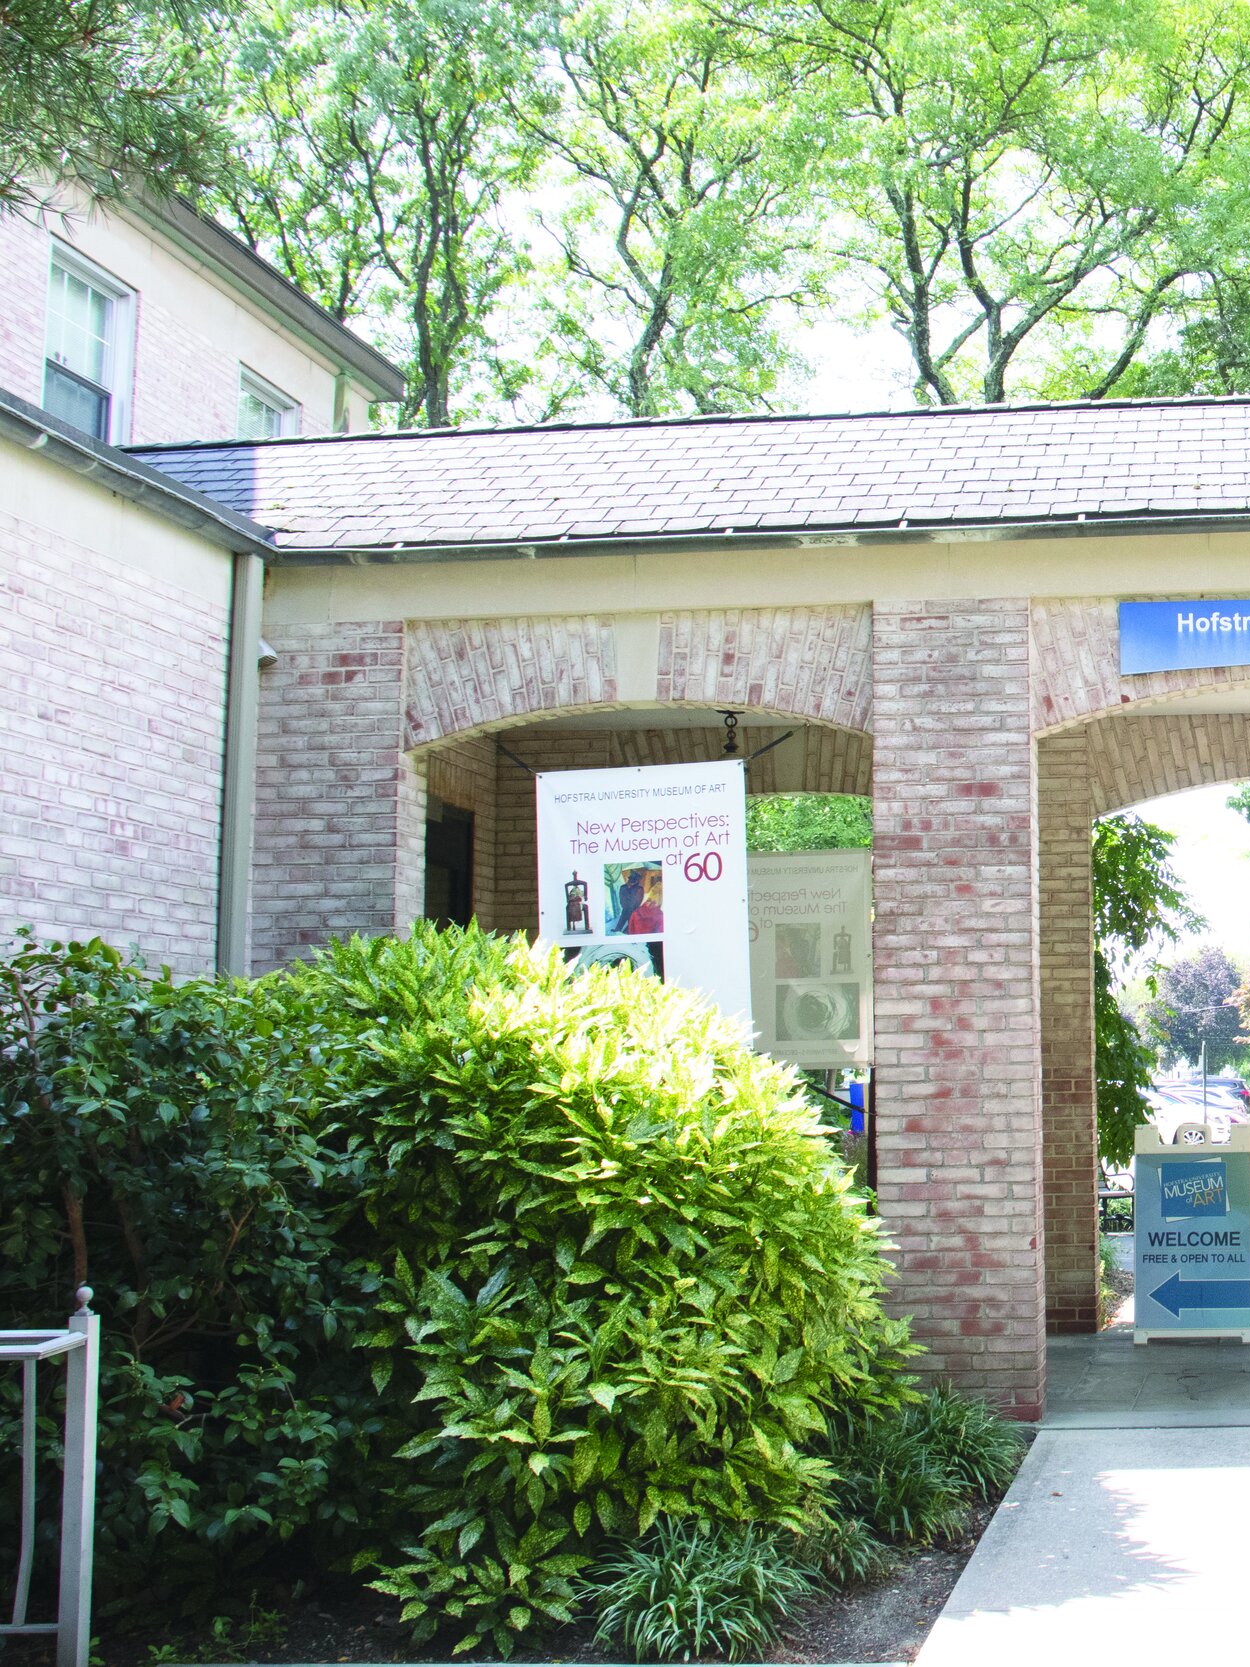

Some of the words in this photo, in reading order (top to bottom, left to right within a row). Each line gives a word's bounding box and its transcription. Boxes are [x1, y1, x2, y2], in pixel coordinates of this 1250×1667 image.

[554, 792, 596, 804] HOFSTRA
[598, 788, 651, 801] UNIVERSITY
[652, 785, 692, 797] MUSEUM
[694, 784, 706, 794] OF
[708, 783, 726, 793] ART
[577, 820, 616, 835] New
[621, 813, 730, 834] Perspectives:
[570, 839, 599, 854] The
[604, 837, 677, 852] Museum
[683, 831, 700, 847] of
[705, 830, 730, 846] Art
[665, 851, 683, 865] at
[684, 851, 723, 882] 60
[1164, 1175, 1224, 1199] MUSEUM
[1186, 1195, 1193, 1204] of
[1193, 1188, 1222, 1208] ART
[1148, 1231, 1241, 1247] WELCOME
[1142, 1254, 1168, 1264] FREE
[1171, 1254, 1177, 1263] &
[1180, 1254, 1208, 1263] OPEN
[1211, 1253, 1225, 1263] TO
[1227, 1253, 1246, 1263] ALL
